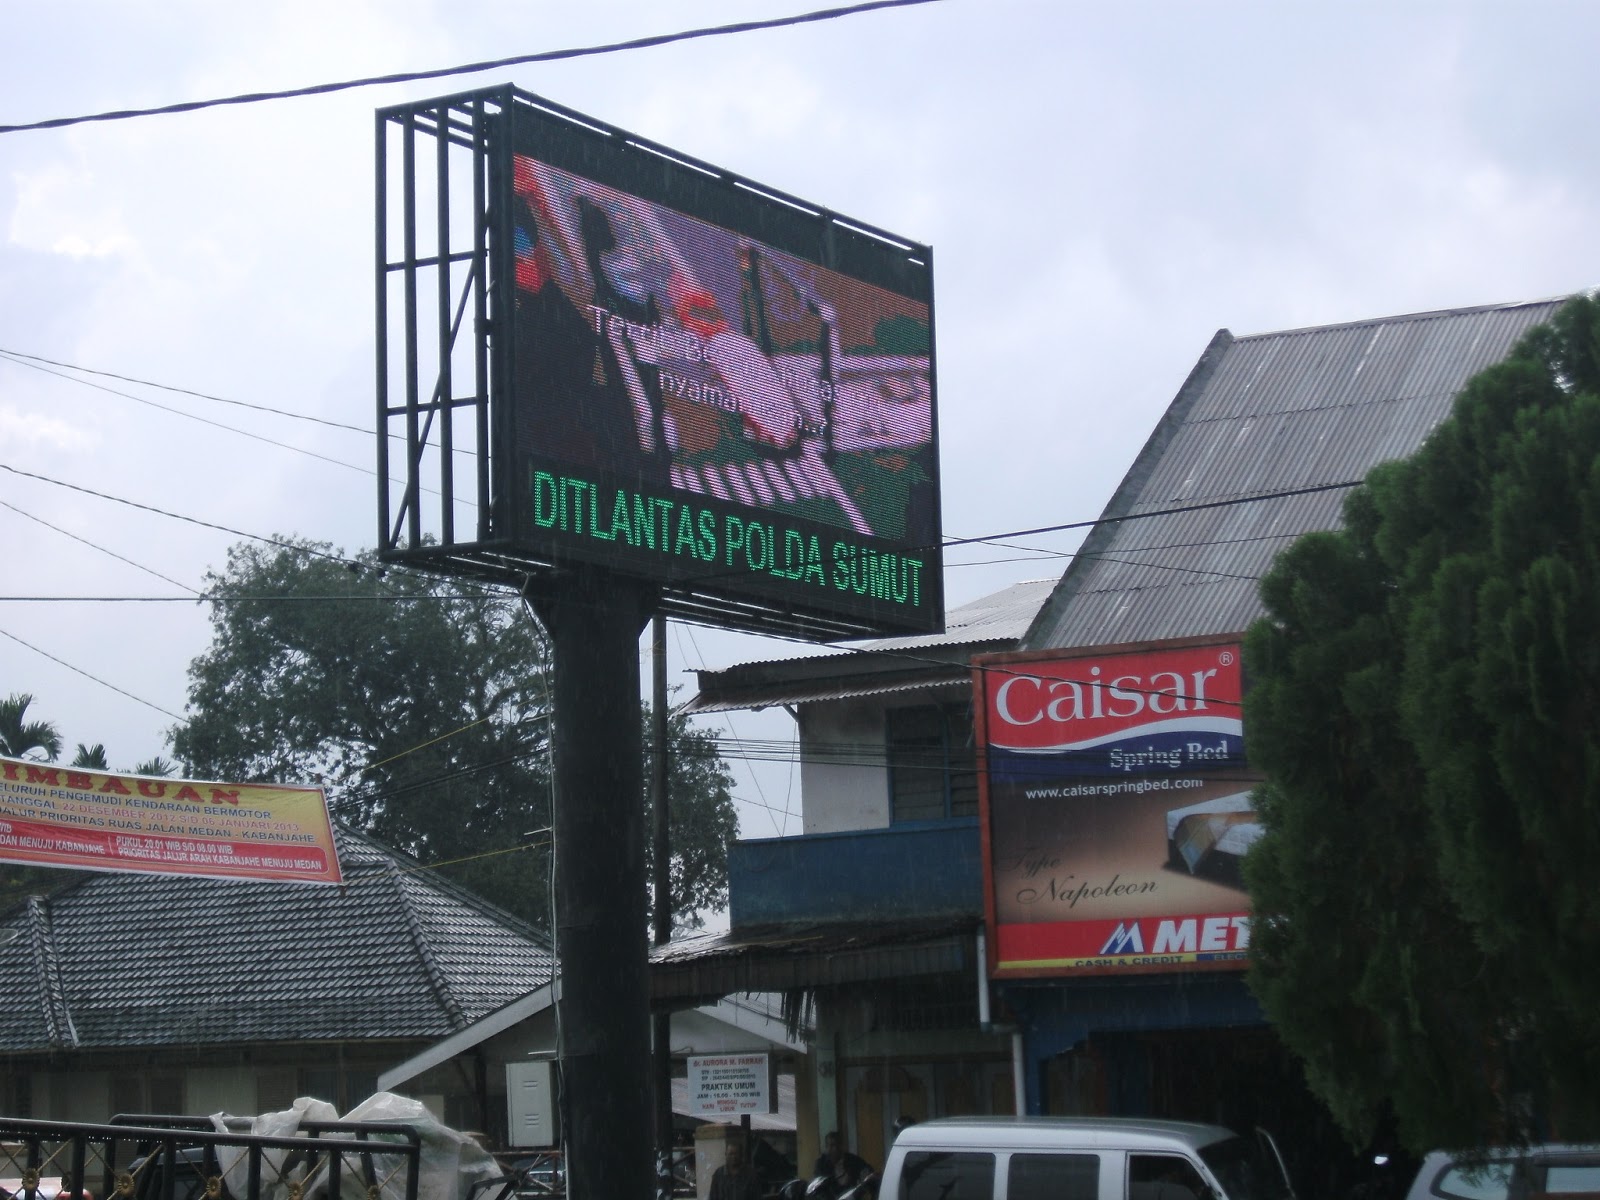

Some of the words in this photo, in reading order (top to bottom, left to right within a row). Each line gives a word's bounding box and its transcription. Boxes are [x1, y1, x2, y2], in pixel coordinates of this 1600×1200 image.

[534, 471, 716, 562] DITLANTAS
[726, 515, 826, 586] POLDA
[833, 541, 923, 607] SUMUT
[996, 666, 1218, 726] Caisar
[1110, 746, 1182, 771] Spring
[2, 762, 240, 806] IMBAUAN
[1025, 778, 1203, 800] www.caisarspringbed.com
[50, 789, 122, 806] PENGEMUDI
[125, 799, 200, 814] KENDARAAN
[204, 806, 272, 820] BERMOTOR
[63, 802, 75, 812] 22
[79, 804, 146, 820] DESEMBER
[150, 813, 176, 822] 2012
[179, 815, 198, 824] S/D
[202, 817, 215, 826] 06
[219, 819, 270, 830] JANUARI
[273, 822, 300, 832] 2013
[40, 811, 105, 827] PRIORITAS
[108, 819, 142, 830] RUAS
[145, 823, 185, 834] JALAN
[188, 827, 231, 838] MEDAN
[242, 831, 315, 843] KABANJAHE
[19, 836, 54, 850] MENUJU
[55, 840, 106, 855] KABANJAHE
[116, 836, 142, 849] PUKUL
[165, 840, 181, 851] WIB
[182, 842, 196, 852] S/D
[217, 845, 233, 855] WIB
[118, 847, 161, 861] PRIORITAS
[162, 851, 188, 862] JALUR
[189, 854, 211, 864] ARAH
[212, 855, 260, 867] KABANJAHE
[261, 858, 294, 869] MENUJU
[294, 860, 322, 870] MEDAN
[1016, 874, 1158, 909] Napoleon
[1075, 958, 1114, 968] CASH
[1117, 957, 1128, 967] &
[701, 1082, 733, 1091] PRAKTEK
[734, 1081, 756, 1090] UMUM
